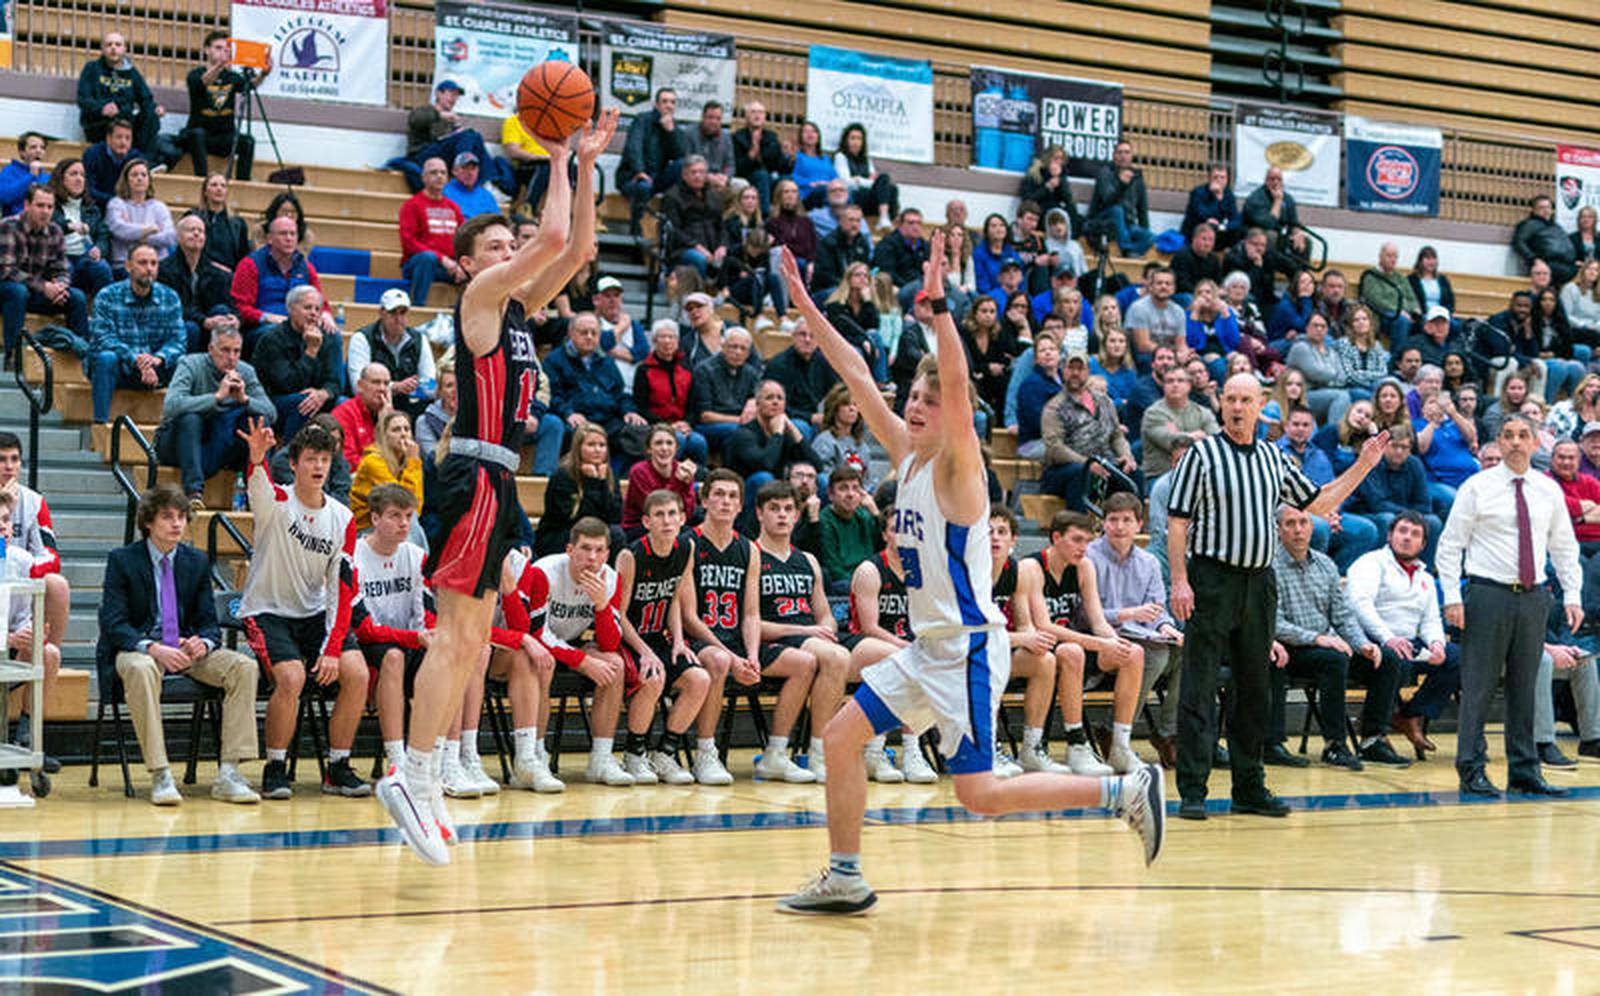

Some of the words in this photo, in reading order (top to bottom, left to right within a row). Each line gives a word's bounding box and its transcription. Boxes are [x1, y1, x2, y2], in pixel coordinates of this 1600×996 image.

[462, 18, 512, 33] CHARLES
[513, 24, 569, 41] ATHLETICS
[832, 89, 907, 117] OLYMPIA
[1045, 101, 1116, 134] POWER
[699, 563, 745, 589] BENET
[761, 574, 813, 595] BENET
[638, 599, 668, 634] 11
[703, 590, 738, 628] 33
